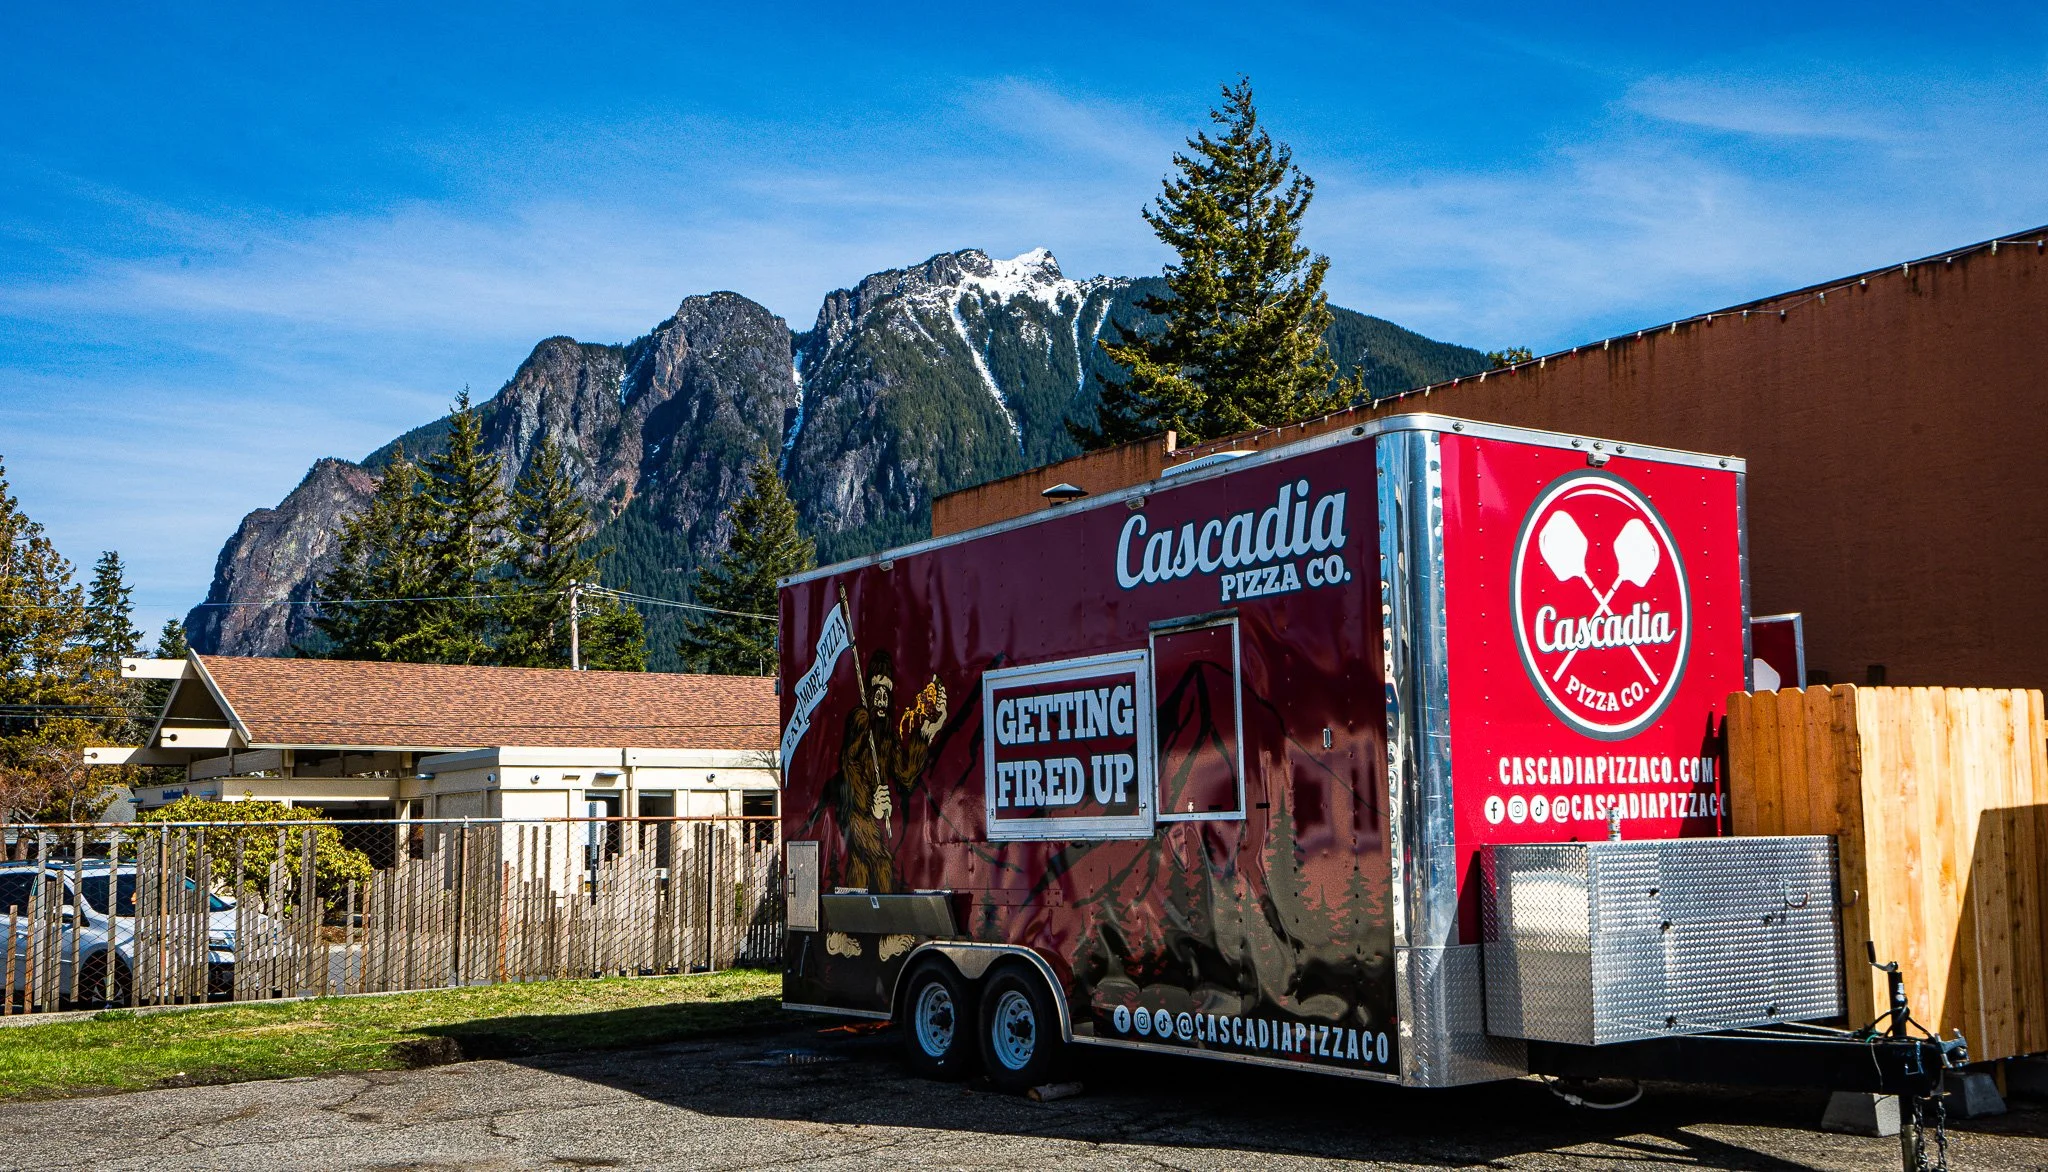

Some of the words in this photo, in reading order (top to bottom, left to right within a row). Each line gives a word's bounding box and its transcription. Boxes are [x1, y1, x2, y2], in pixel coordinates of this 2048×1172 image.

[1116, 479, 1347, 589] Cascadia
[1221, 563, 1301, 602] PIZZA
[1306, 554, 1351, 587] CO.
[1535, 602, 1677, 653] Cascadia
[786, 709, 803, 749] EAT
[799, 667, 823, 708] MORE
[820, 616, 846, 667] PIZZA
[1565, 675, 1620, 711] PIZZA
[1621, 681, 1650, 708] CO.
[995, 685, 1135, 746] GETTING
[997, 756, 1085, 807] FIRED
[1091, 753, 1135, 805] UP
[1499, 756, 1713, 785] CASCADIAPIZZACO.COM
[1175, 1012, 1389, 1065] @CASCADIAPIZZACO
